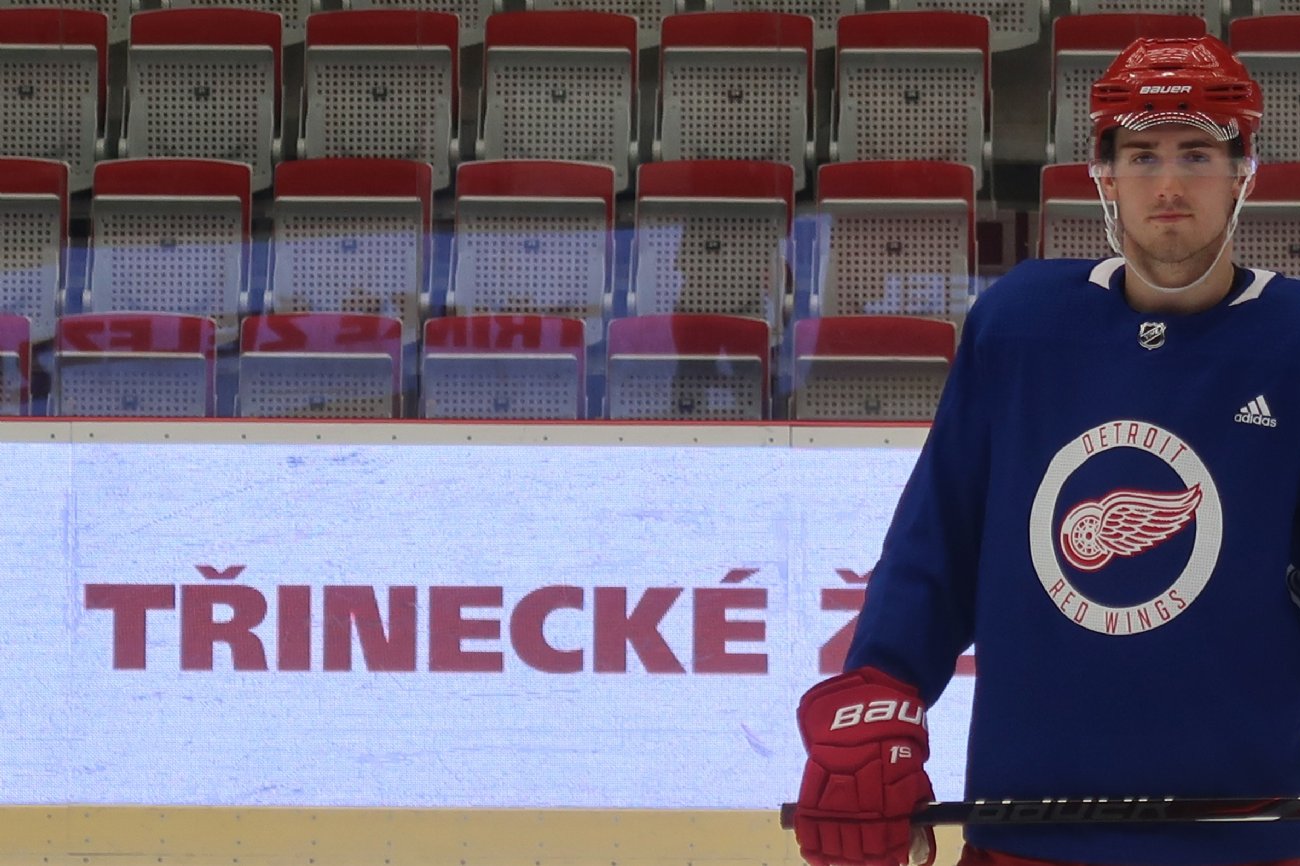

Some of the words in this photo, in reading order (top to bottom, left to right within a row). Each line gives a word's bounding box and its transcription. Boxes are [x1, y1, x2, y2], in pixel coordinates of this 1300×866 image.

[1139, 85, 1192, 94] BAUER
[1234, 413, 1277, 428] adidas
[1081, 422, 1187, 463] DETROIT
[84, 564, 769, 674] TŘINECKÉ
[1049, 578, 1089, 624] RED
[1105, 589, 1187, 634] WINGS
[829, 700, 928, 731] BAU
